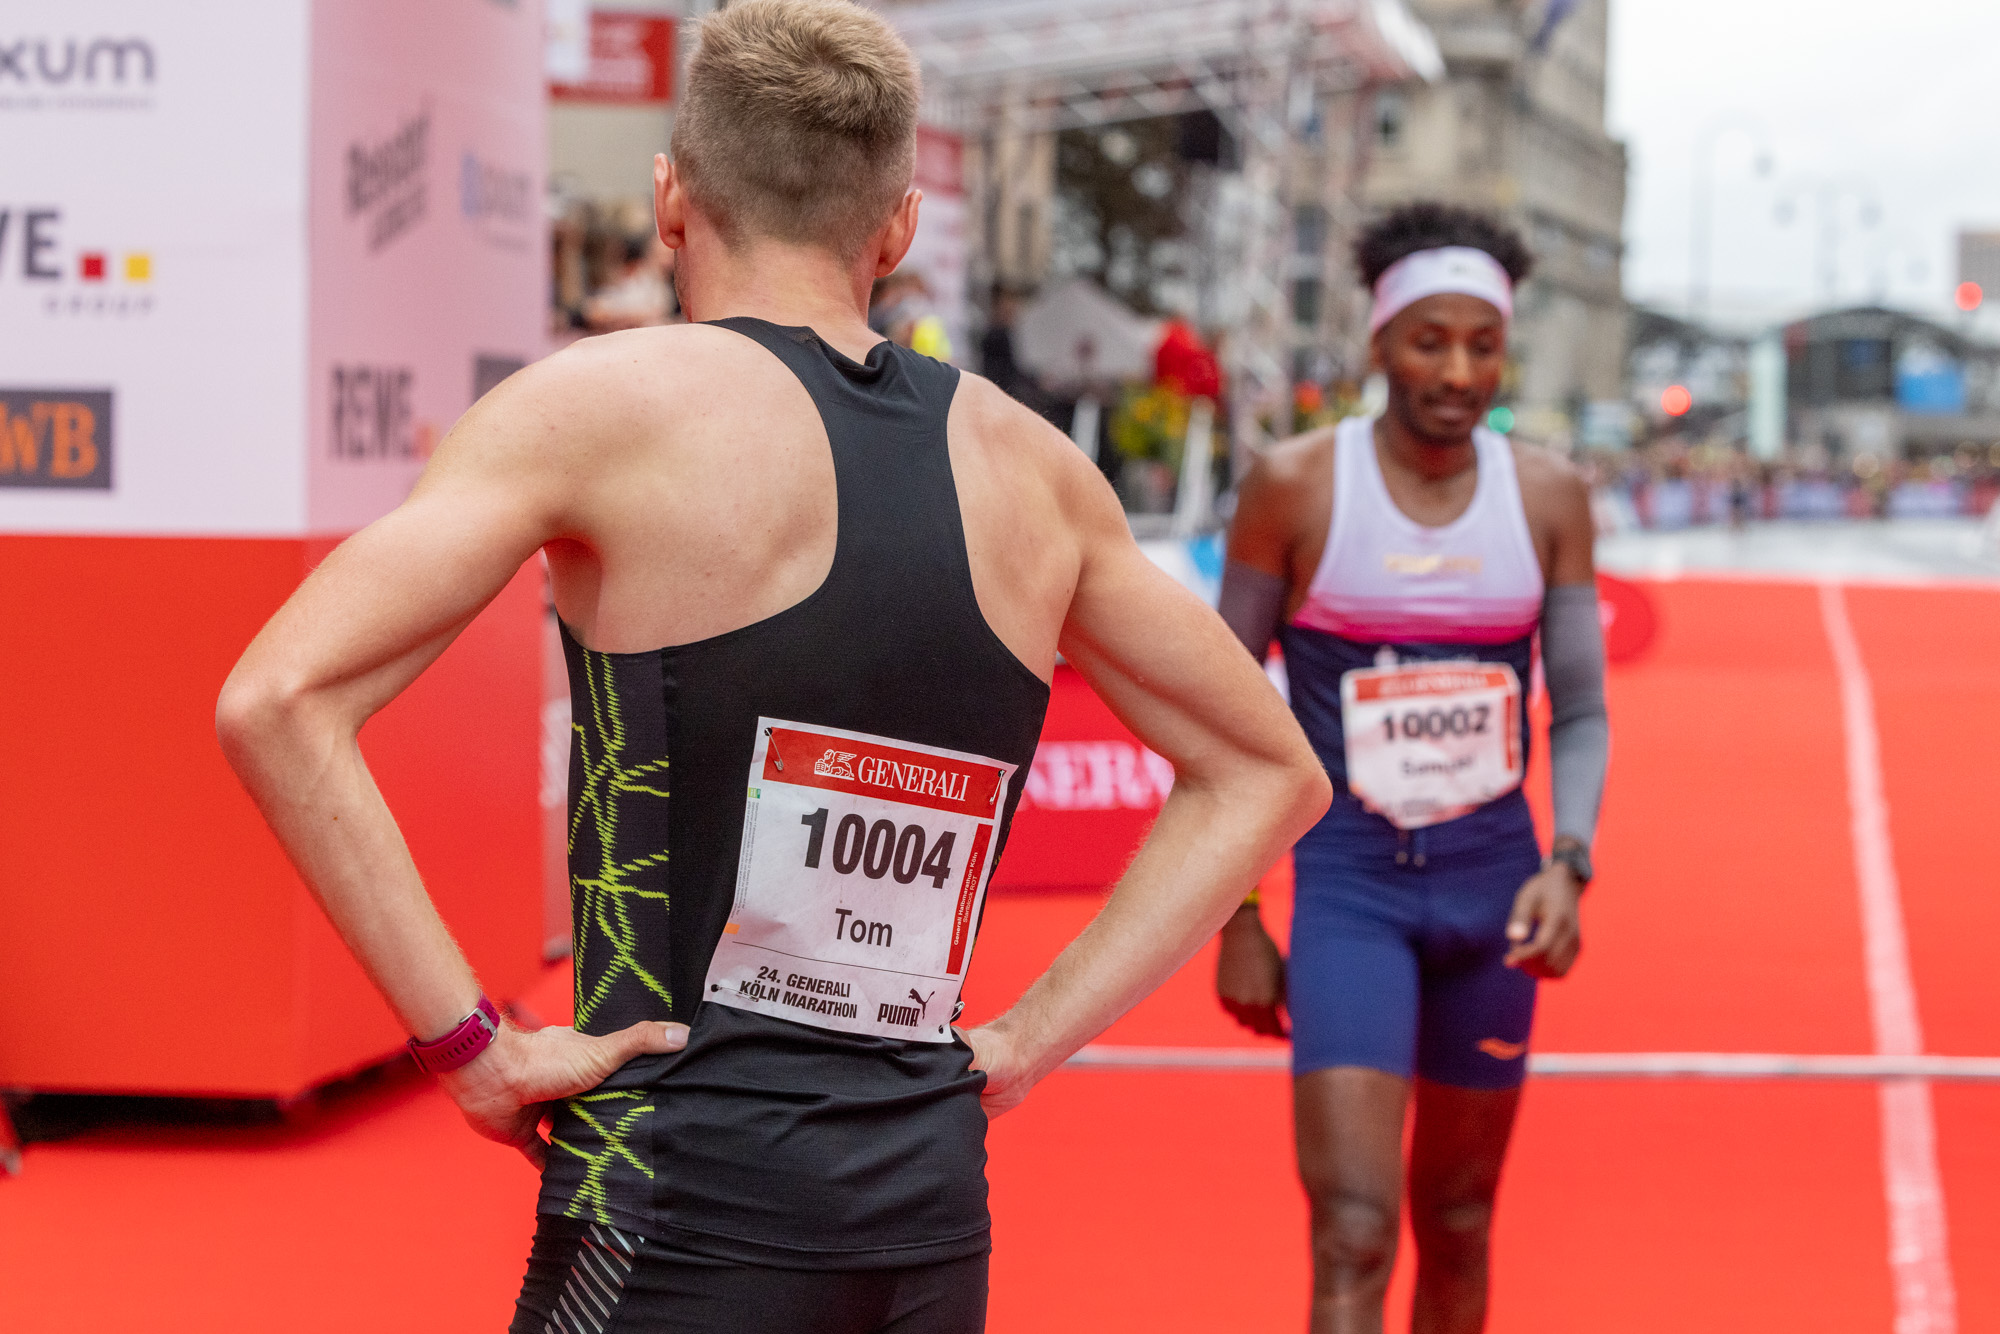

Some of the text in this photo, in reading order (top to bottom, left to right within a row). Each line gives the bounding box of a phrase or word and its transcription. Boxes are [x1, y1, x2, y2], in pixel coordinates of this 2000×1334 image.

[0, 208, 61, 281] E
[1383, 704, 1489, 742] 10002
[857, 756, 971, 802] GENERALI
[801, 807, 957, 889] 10004
[953, 852, 978, 946] Generali Halbmarathon Köln
[963, 876, 978, 923] Startblock ROT
[835, 908, 893, 947] Tom
[739, 980, 858, 1019] KÖLN MARATHON
[757, 966, 851, 998] 24. GENERALI
[876, 1003, 921, 1028] PUMA
